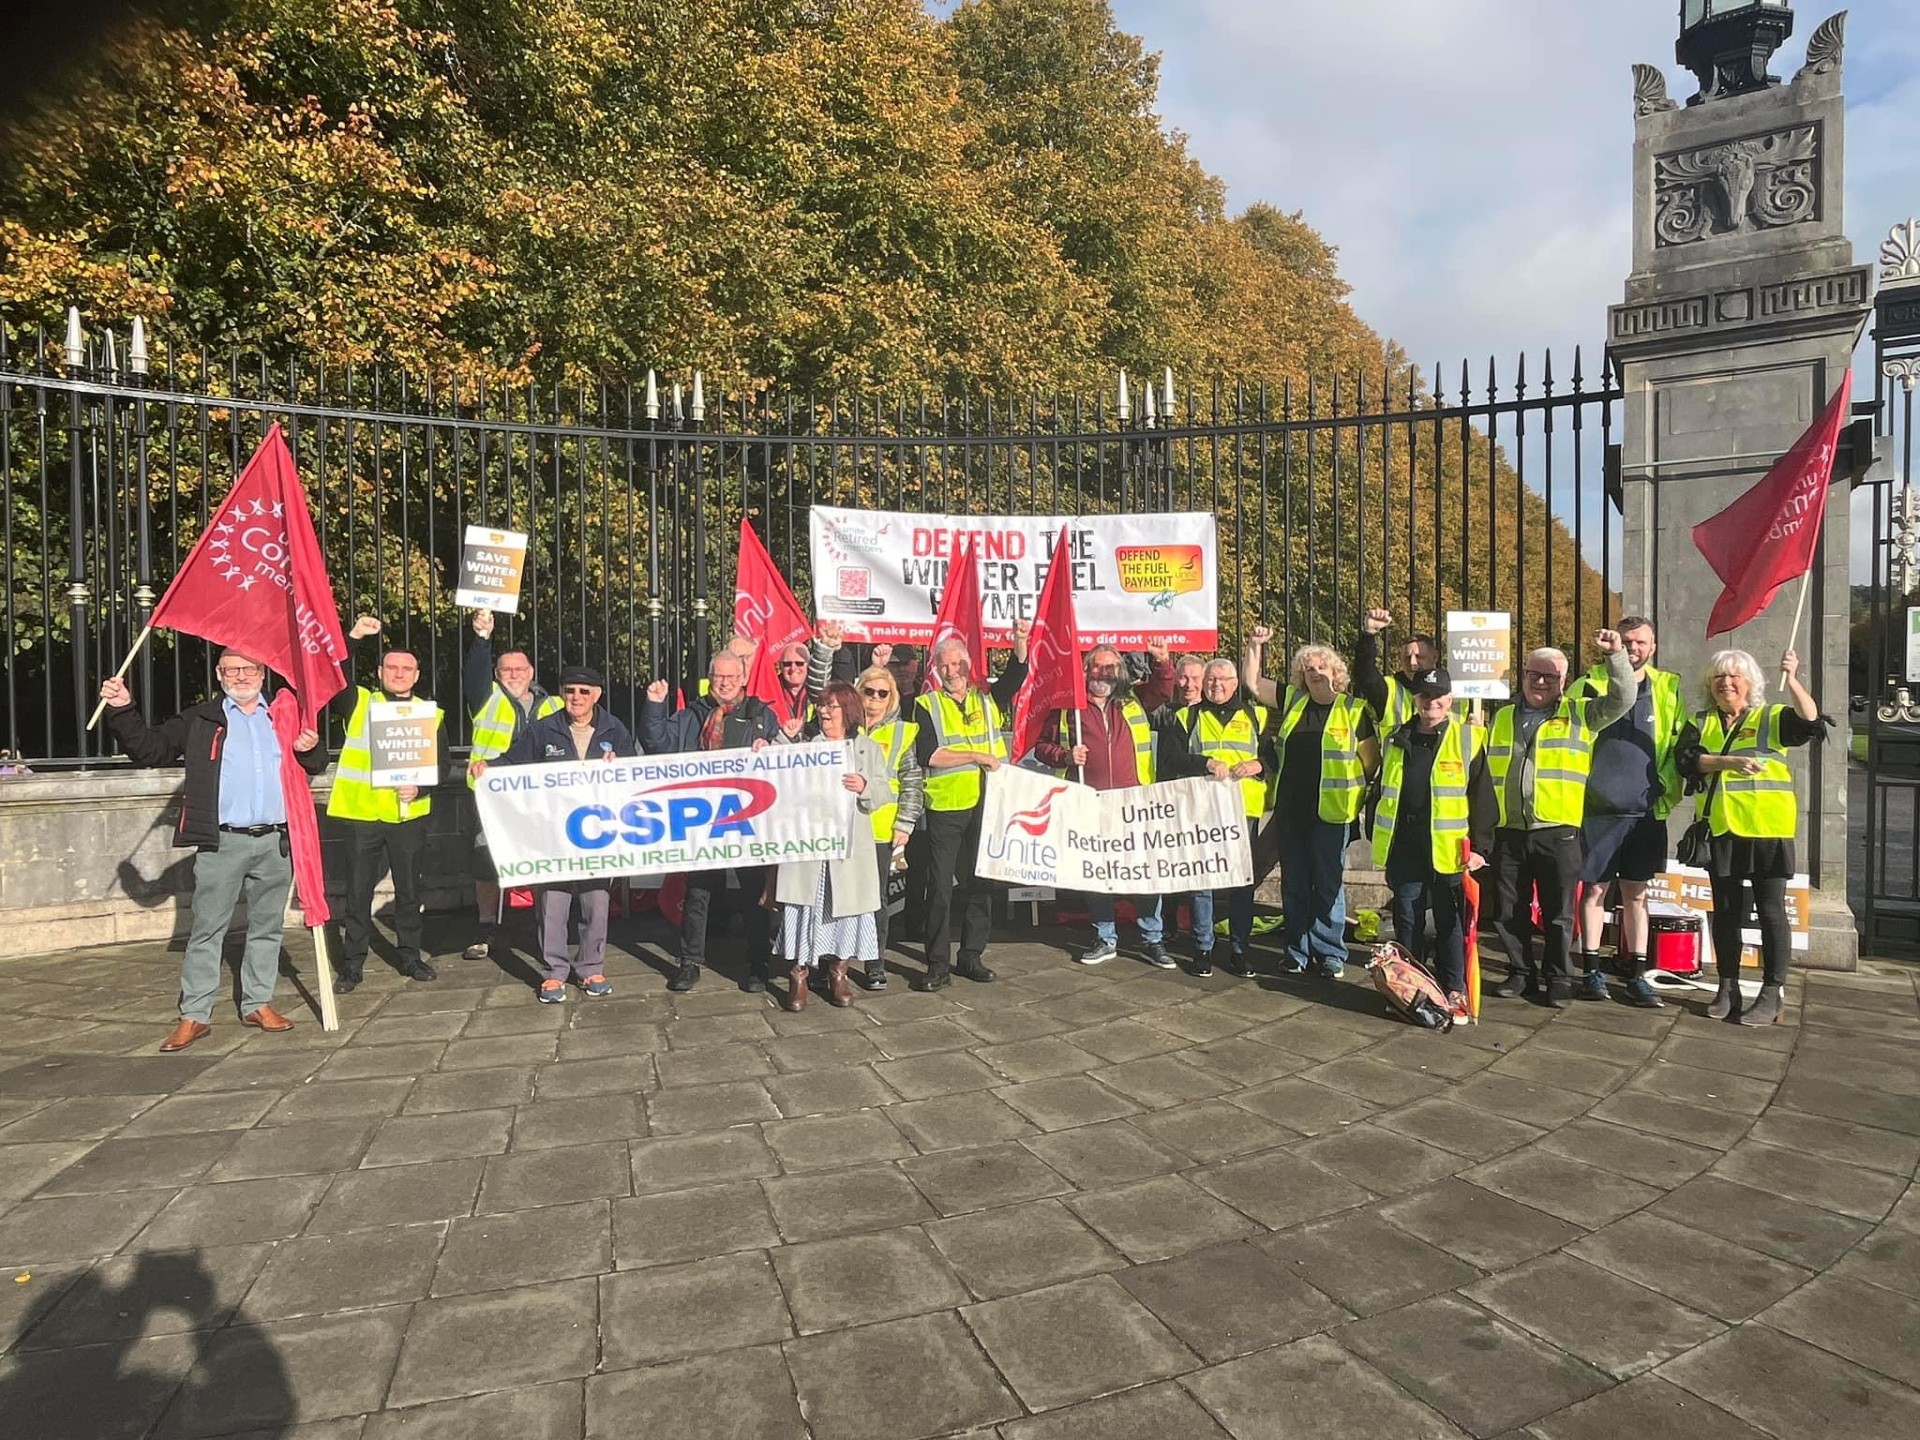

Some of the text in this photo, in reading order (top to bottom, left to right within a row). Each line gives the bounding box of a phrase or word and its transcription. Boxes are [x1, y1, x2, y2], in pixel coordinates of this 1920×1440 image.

[834, 531, 878, 545] Retired
[913, 528, 1025, 560] DEEND
[475, 551, 510, 564] SAVE
[1119, 550, 1160, 561] DEFEND
[466, 561, 517, 577] WINTER
[1122, 563, 1170, 573] THE FUEL
[473, 575, 506, 587] FUEL
[1034, 562, 1106, 591] FEL
[1125, 575, 1173, 588] PAYMENT
[872, 626, 906, 636] make
[1098, 633, 1116, 644] did
[1118, 634, 1143, 645] not
[1460, 637, 1496, 648] SAVE
[1452, 649, 1504, 661] WINTER
[1462, 662, 1495, 673] FUEL
[385, 727, 422, 737] SAVE
[376, 739, 431, 750] WINTER
[387, 751, 422, 762] FUEL
[488, 751, 843, 792] CIVIL SERVICE PENSIONERS' ALLIANCE
[1122, 800, 1175, 823] Unite
[565, 794, 755, 849] CSPA
[1068, 824, 1241, 853] Retired Members
[499, 836, 845, 878] NORTHERN IRELAND BRANCH
[1083, 852, 1229, 880] Belfast Branch
